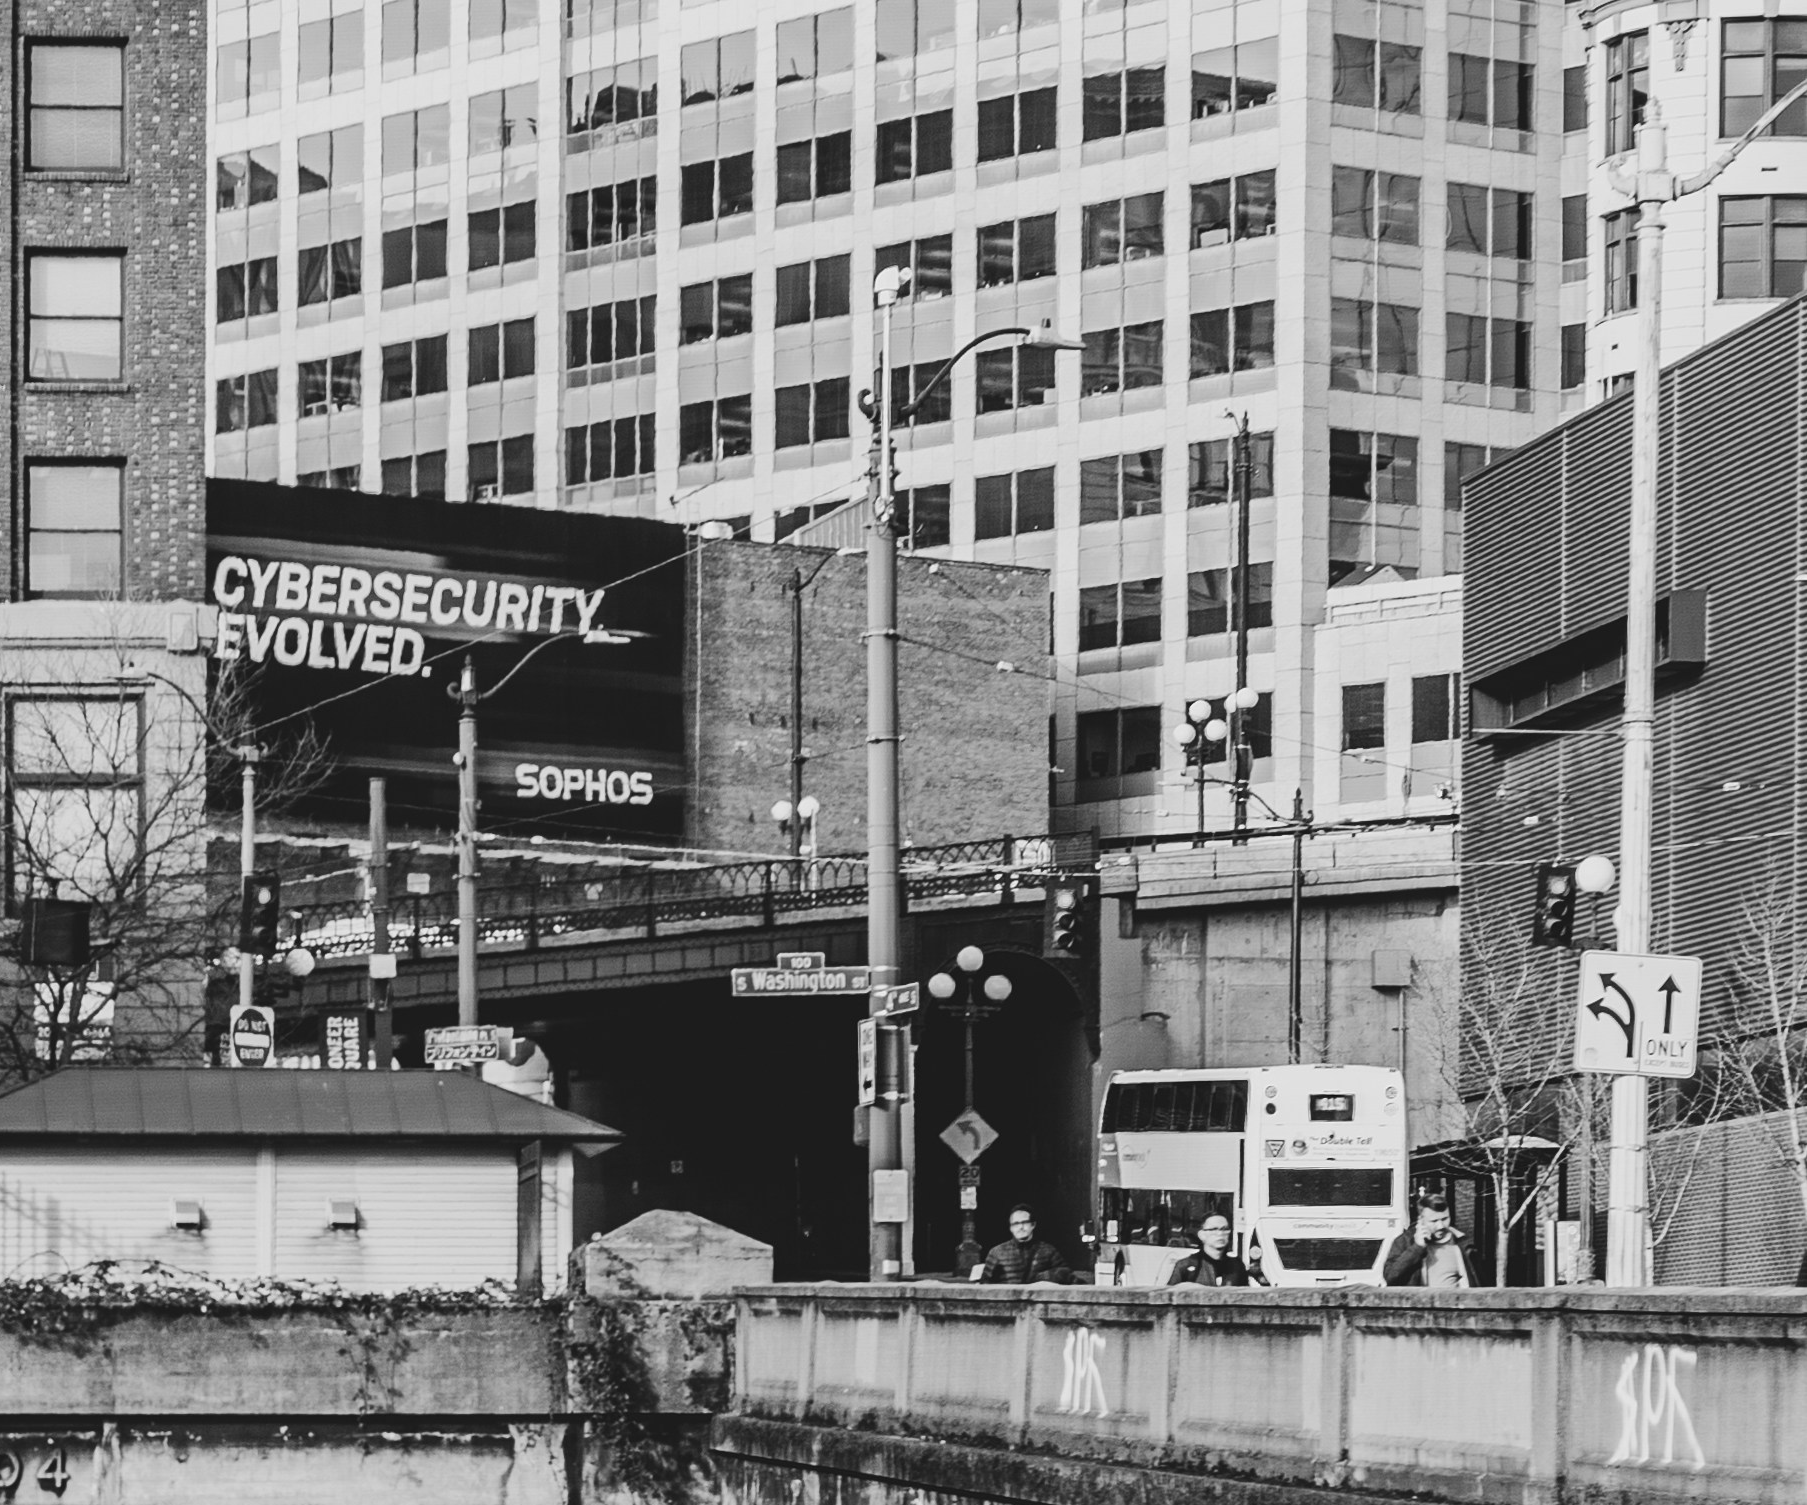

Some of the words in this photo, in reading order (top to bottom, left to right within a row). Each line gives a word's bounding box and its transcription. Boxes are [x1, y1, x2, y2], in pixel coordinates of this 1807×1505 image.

[213, 555, 605, 634] CYBERSECURITY
[214, 613, 432, 678] EVOLVED.
[515, 762, 653, 805] SOPHOS
[791, 957, 812, 969] 100
[736, 975, 747, 991] S
[751, 969, 846, 994] Washington
[1646, 1039, 1687, 1058] ONLY
